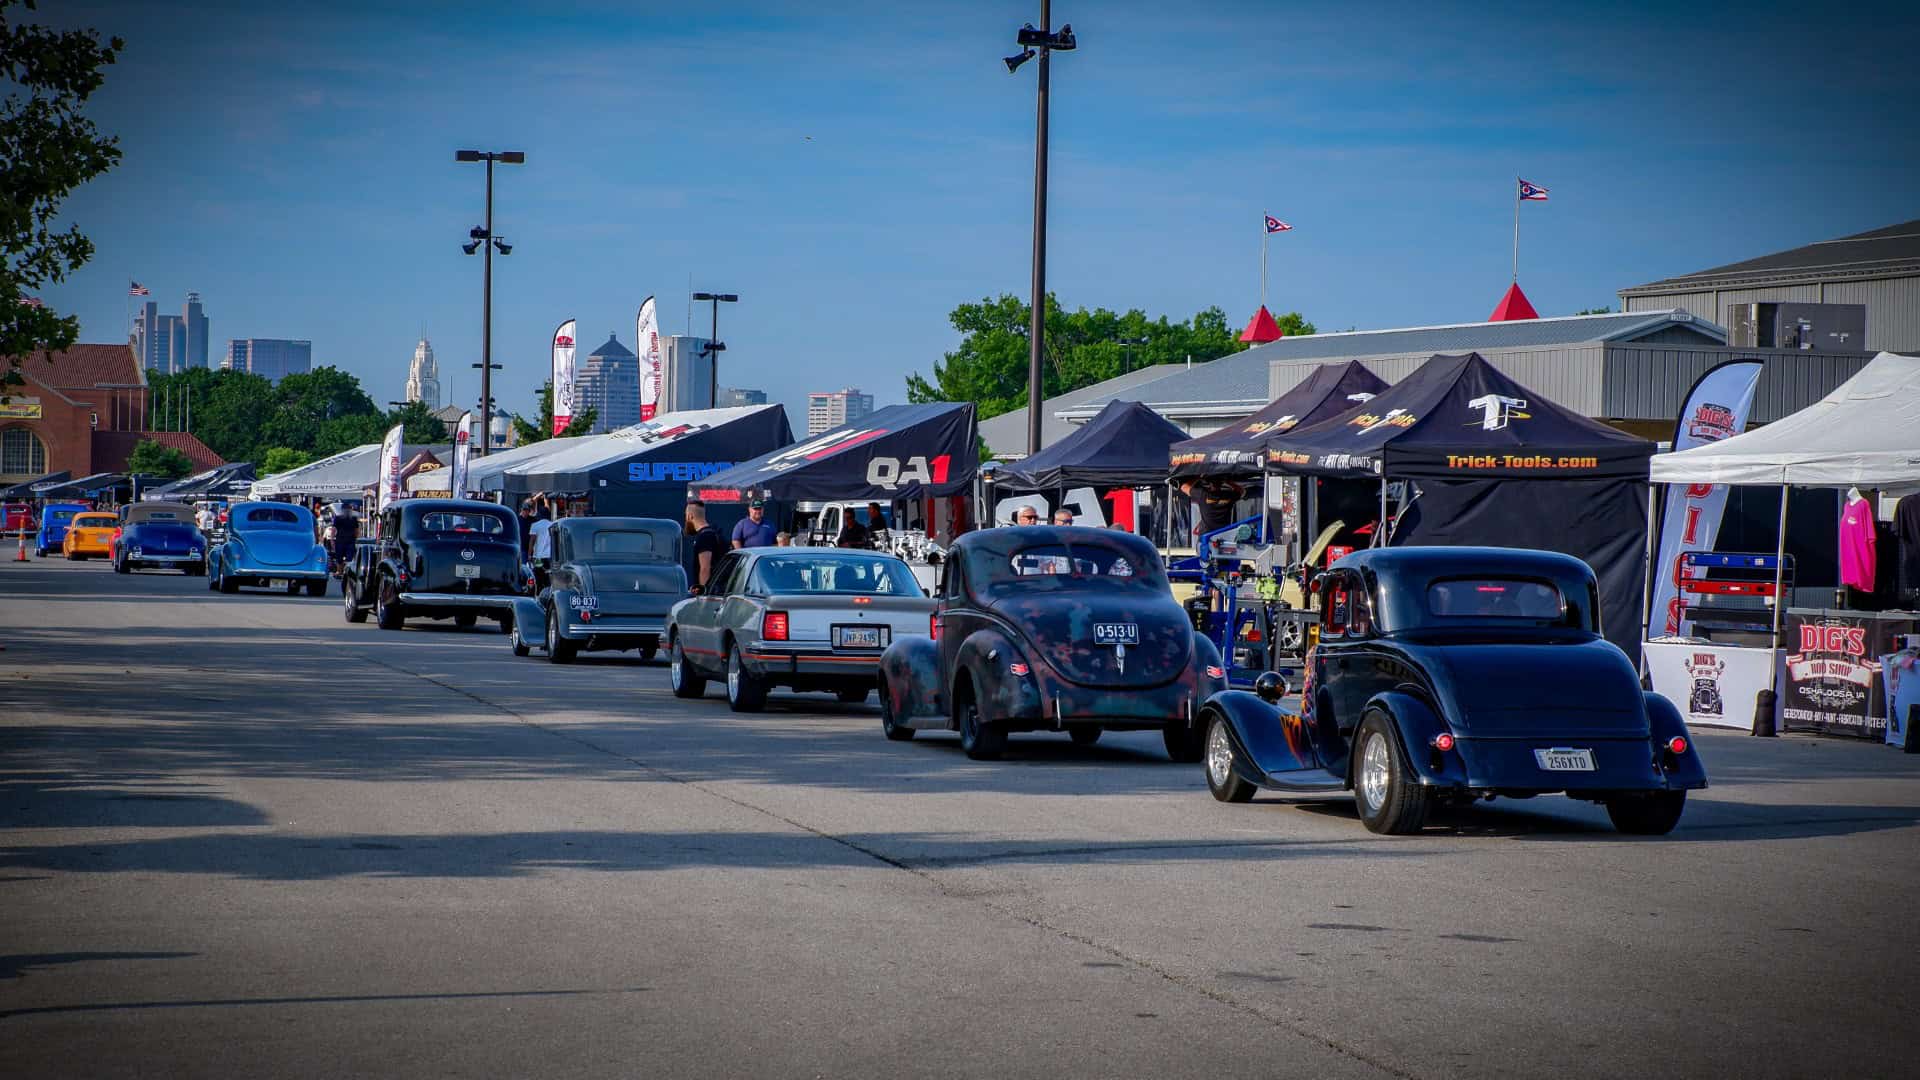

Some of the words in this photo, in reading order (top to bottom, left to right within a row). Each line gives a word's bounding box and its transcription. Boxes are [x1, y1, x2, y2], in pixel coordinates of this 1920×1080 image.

[866, 455, 951, 490] QA1
[1447, 455, 1598, 469] Trick-Tools.com
[1800, 625, 1865, 655] DIG'S
[1548, 757, 1586, 768] 256XTD
